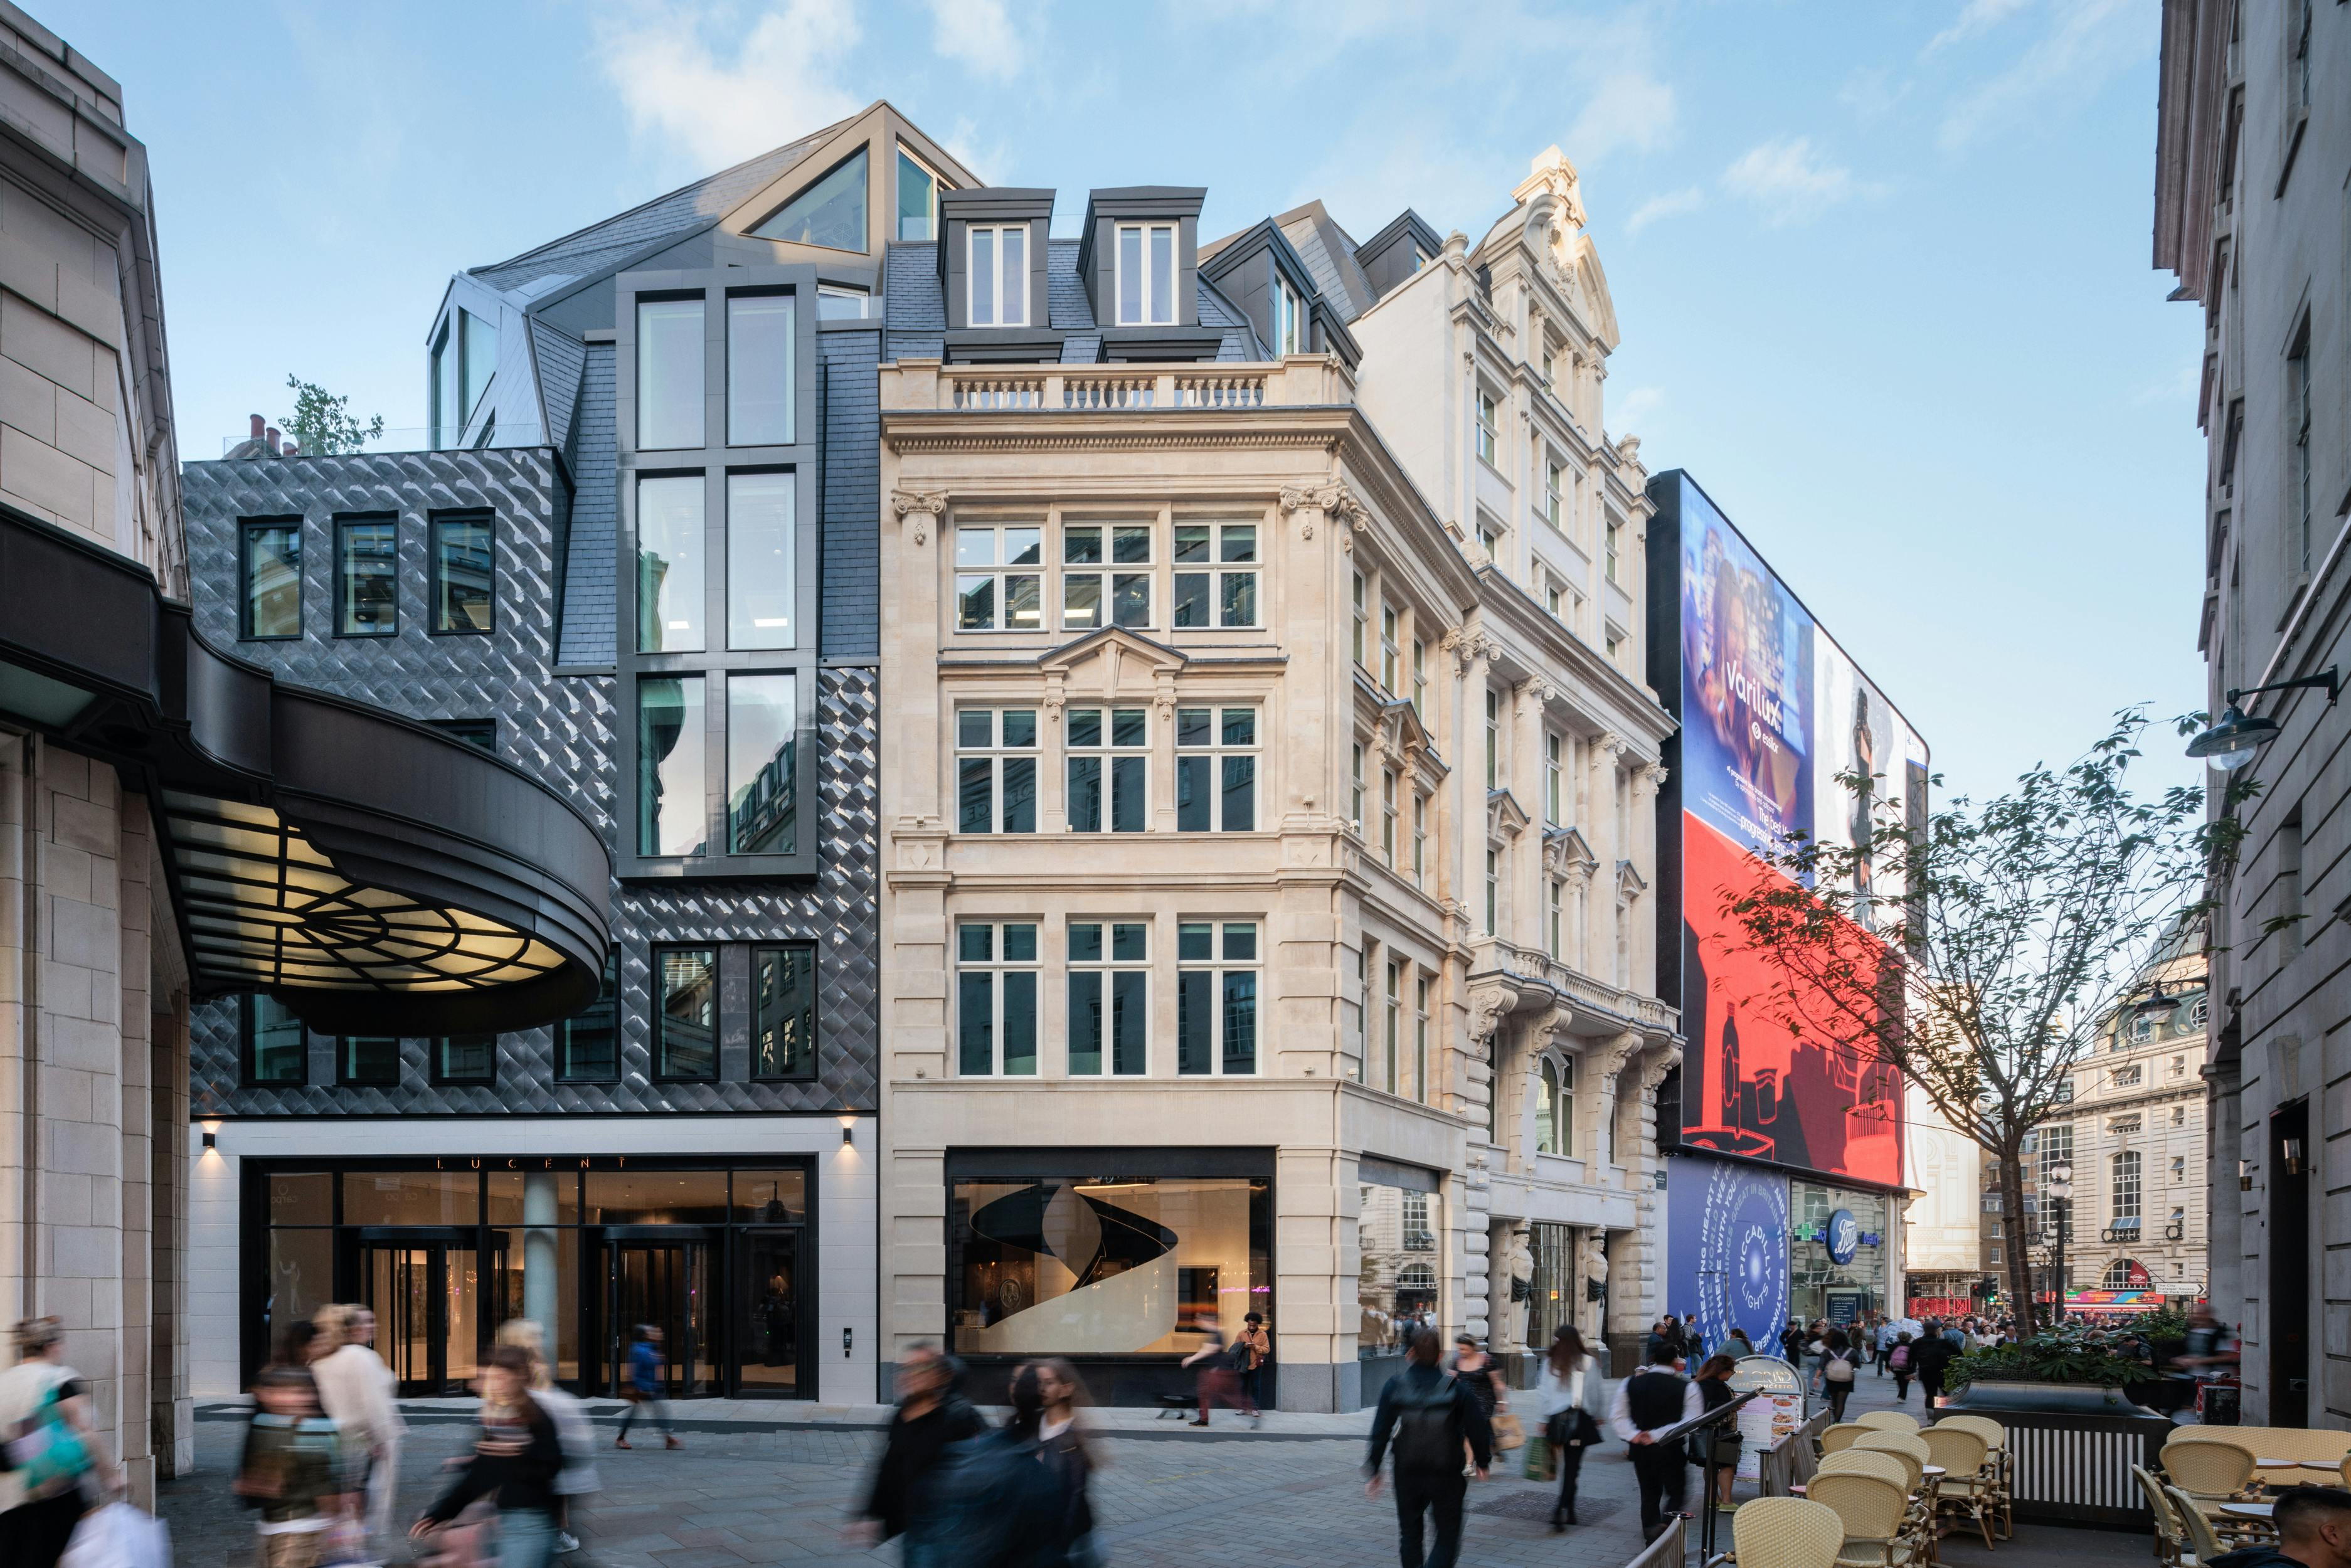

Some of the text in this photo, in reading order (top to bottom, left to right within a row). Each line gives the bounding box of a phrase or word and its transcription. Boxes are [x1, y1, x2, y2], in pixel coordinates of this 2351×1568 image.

[1762, 733, 1778, 754] essilor
[1758, 807, 1769, 827] The
[1770, 815, 1781, 835] best
[437, 1157, 625, 1169] LUCENT
[1716, 1178, 1726, 1204] WE
[1724, 1179, 1736, 1207] YOU
[1774, 1187, 1785, 1214] AND
[1702, 1183, 1714, 1242] HEART
[1707, 1209, 1719, 1276] WORLD
[1717, 1210, 1727, 1253] WITH
[1834, 1219, 1856, 1255] Boots
[1732, 1185, 1749, 1223] GREAT
[1750, 1183, 1757, 1195] IN
[1758, 1184, 1779, 1226] BRITAIN
[1770, 1268, 1785, 1333] BEATING
[1739, 1225, 1771, 1281] PICCADILLY
[1699, 1247, 1708, 1324] BEATING
[1707, 1282, 1715, 1320] THE
[1714, 1259, 1724, 1320] THERE
[1741, 1281, 1769, 1310] LIGHTS
[1705, 1325, 1711, 1337] A
